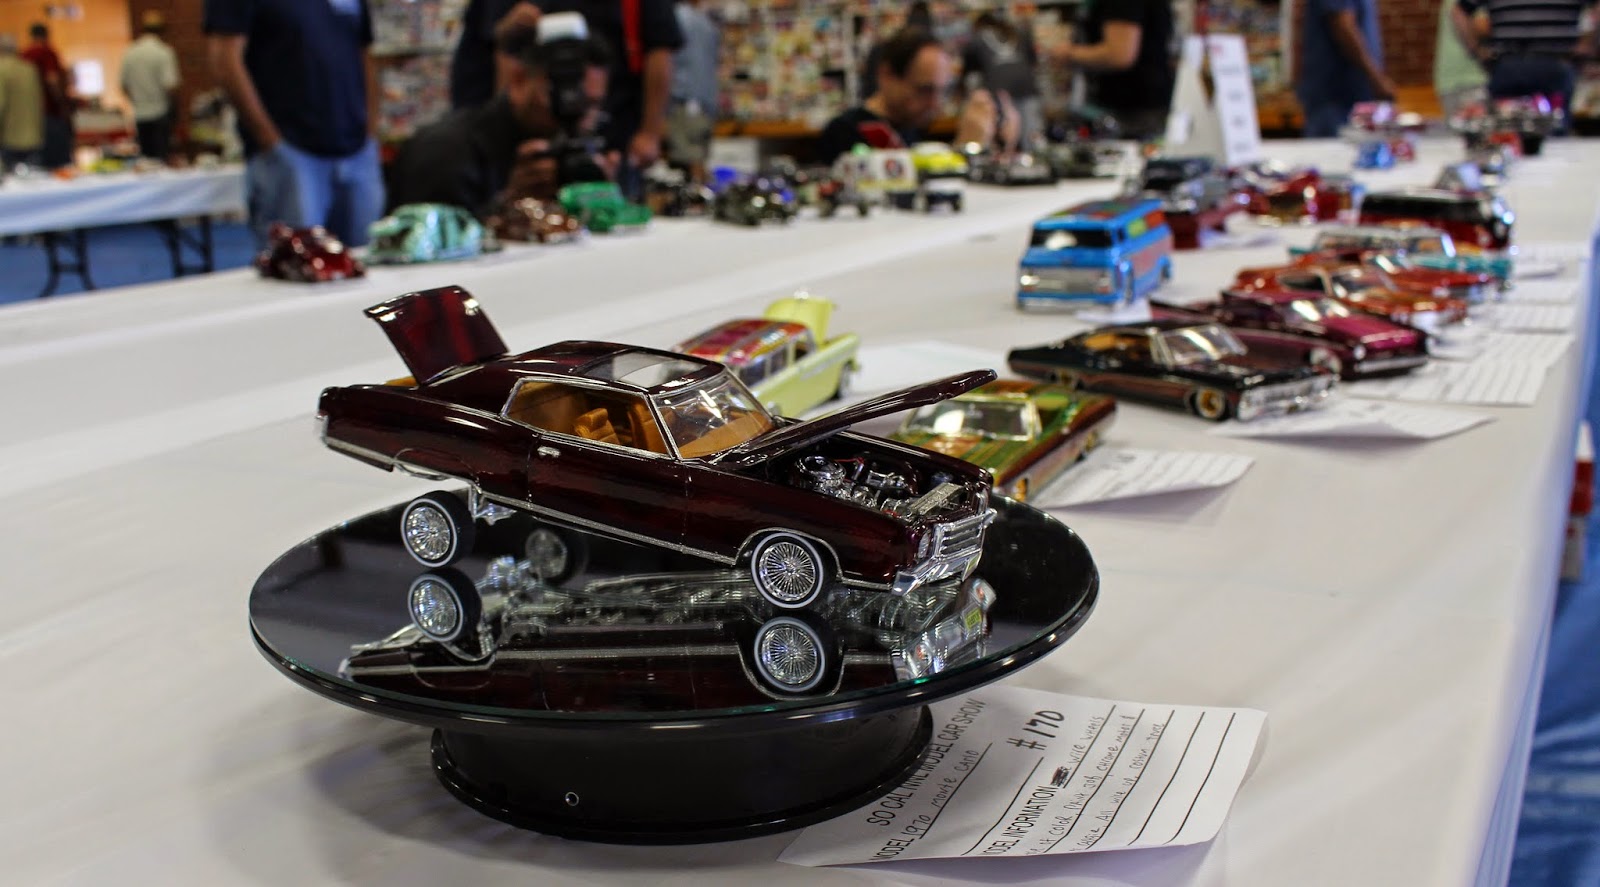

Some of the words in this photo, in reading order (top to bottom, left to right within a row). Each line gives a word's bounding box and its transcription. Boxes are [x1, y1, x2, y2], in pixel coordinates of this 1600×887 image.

[951, 698, 987, 725] SHOW
[937, 722, 969, 741] CAR
[880, 792, 914, 809] CAL
[866, 810, 896, 827] SO
[1000, 785, 1060, 839] INFORMATION
[901, 814, 932, 836] 1970
[981, 839, 1020, 854] ODEL
